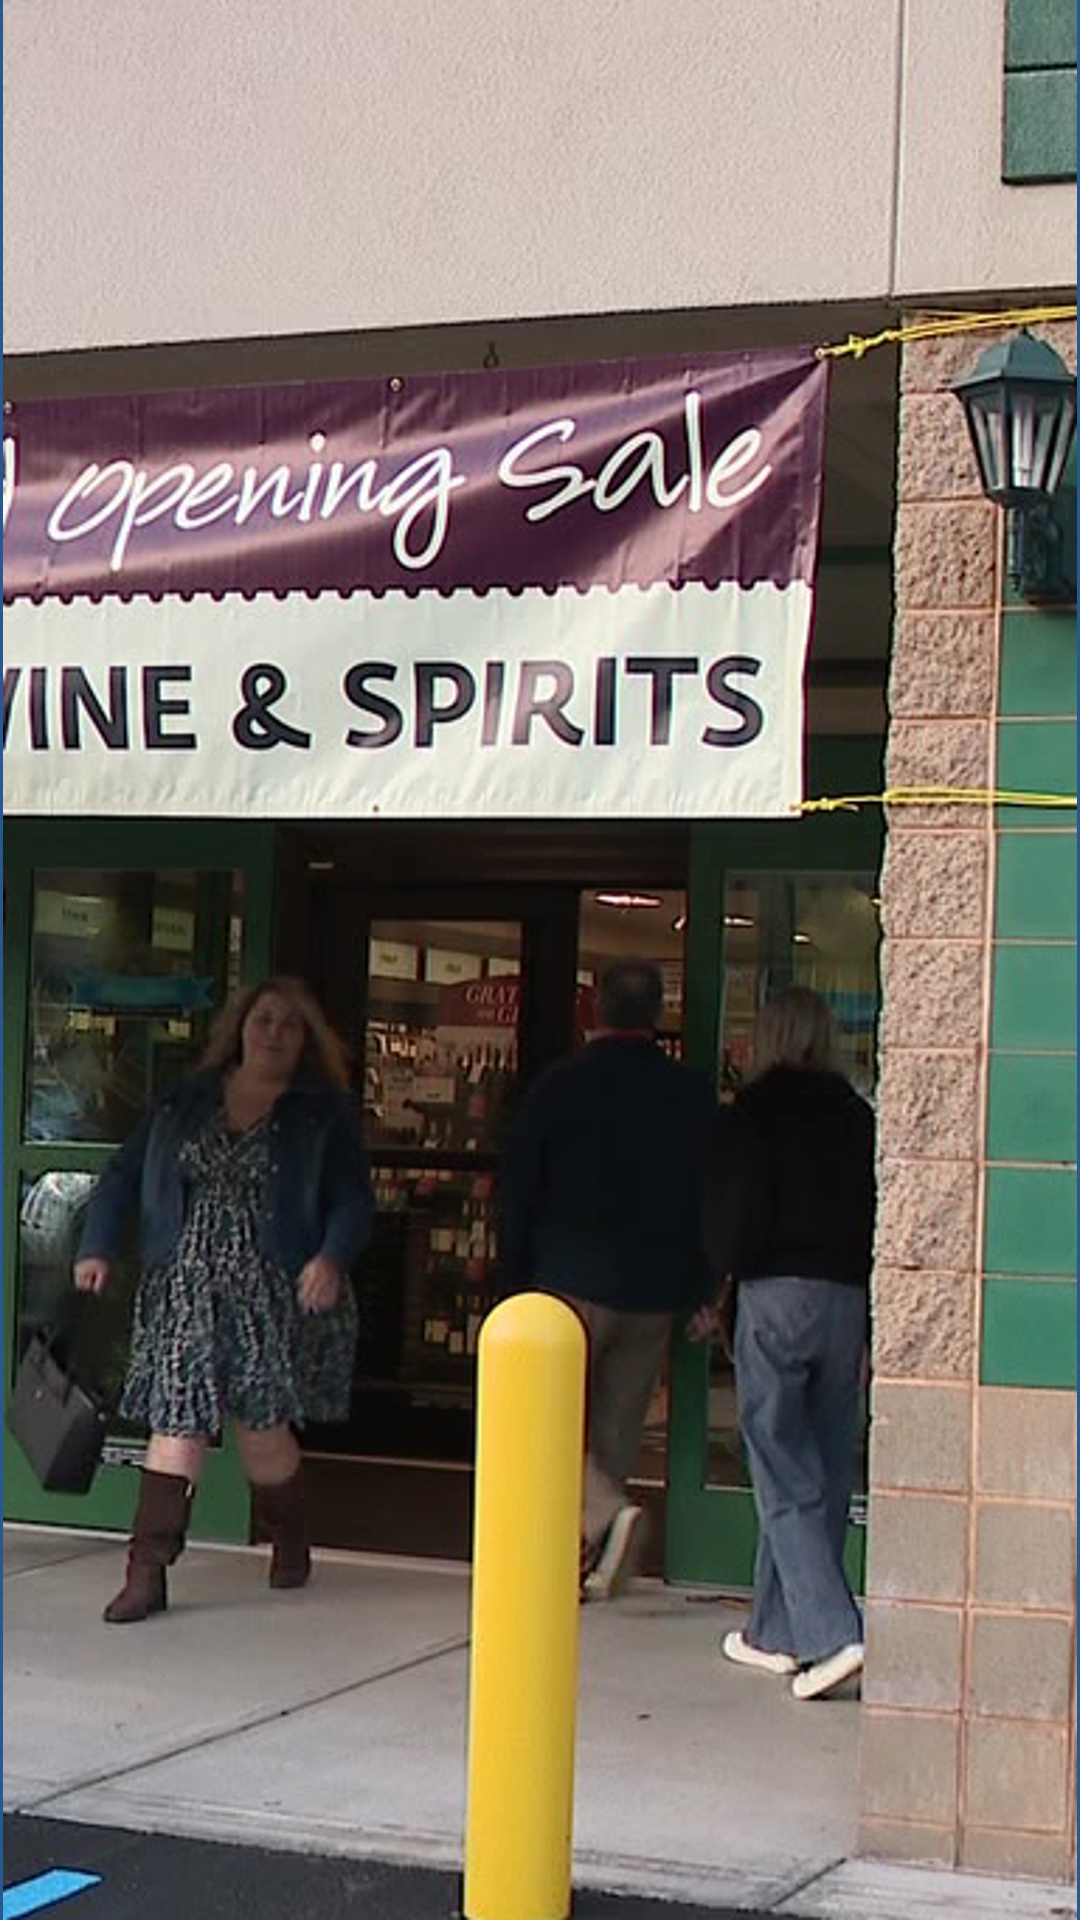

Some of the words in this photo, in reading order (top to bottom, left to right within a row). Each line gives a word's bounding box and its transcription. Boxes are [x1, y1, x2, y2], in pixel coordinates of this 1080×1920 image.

[47, 432, 466, 572] opening
[3, 664, 198, 751] INE
[232, 662, 312, 751] &
[344, 655, 765, 751] SPIRITS
